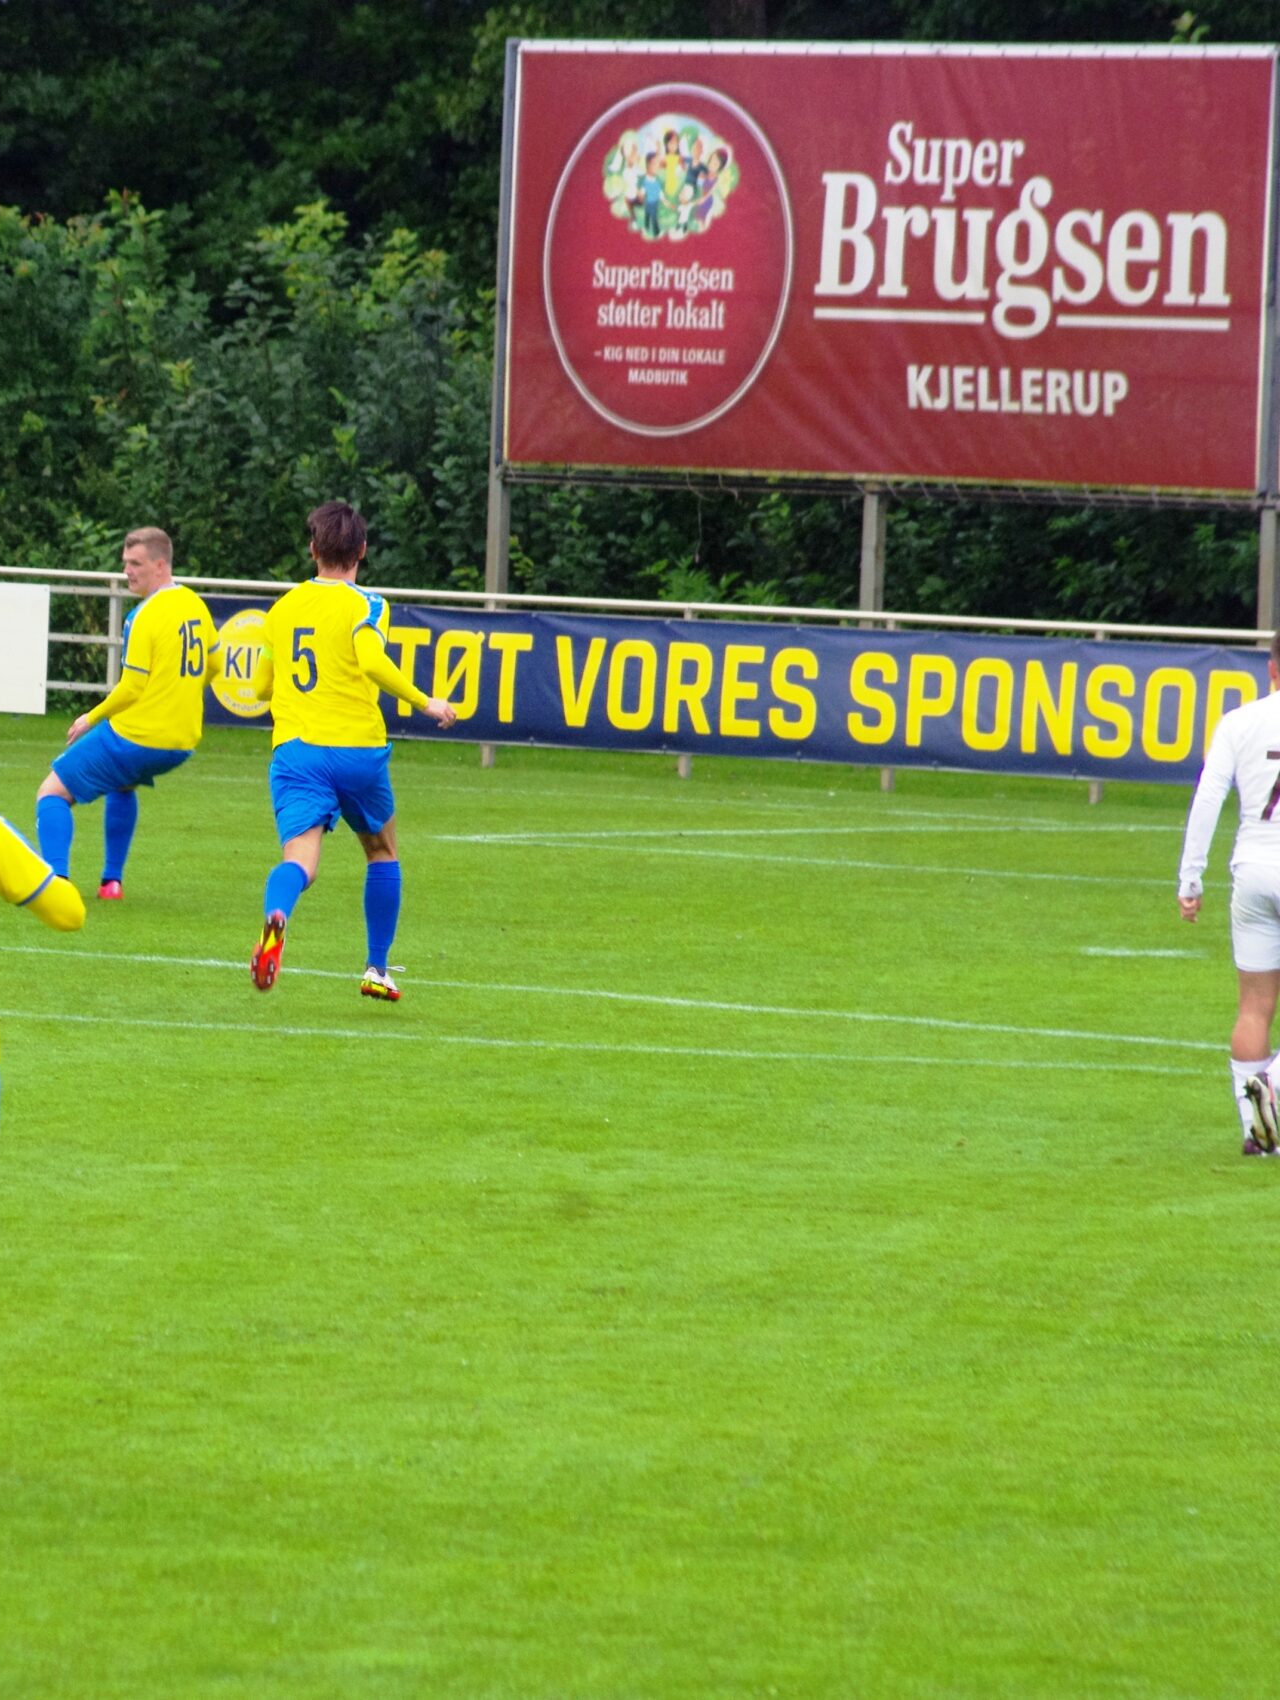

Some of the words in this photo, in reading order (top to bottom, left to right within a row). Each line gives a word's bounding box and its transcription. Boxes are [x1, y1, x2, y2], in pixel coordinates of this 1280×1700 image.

[884, 120, 1024, 202] Super
[592, 257, 735, 297] SuperBrugsen
[813, 170, 1232, 339] Brugsen
[596, 298, 662, 329] støtter
[665, 296, 725, 330] lokalt
[603, 345, 623, 362] KIG
[625, 346, 649, 362] NED
[658, 347, 680, 364] DIN
[682, 347, 726, 366] LOKALE
[627, 367, 688, 386] MADBUTIK
[906, 363, 1129, 418] KJELLERUP
[178, 619, 204, 678] 15
[224, 646, 263, 680] KI
[291, 627, 318, 693] 5
[384, 626, 534, 724] TØT
[556, 634, 820, 741] VORES
